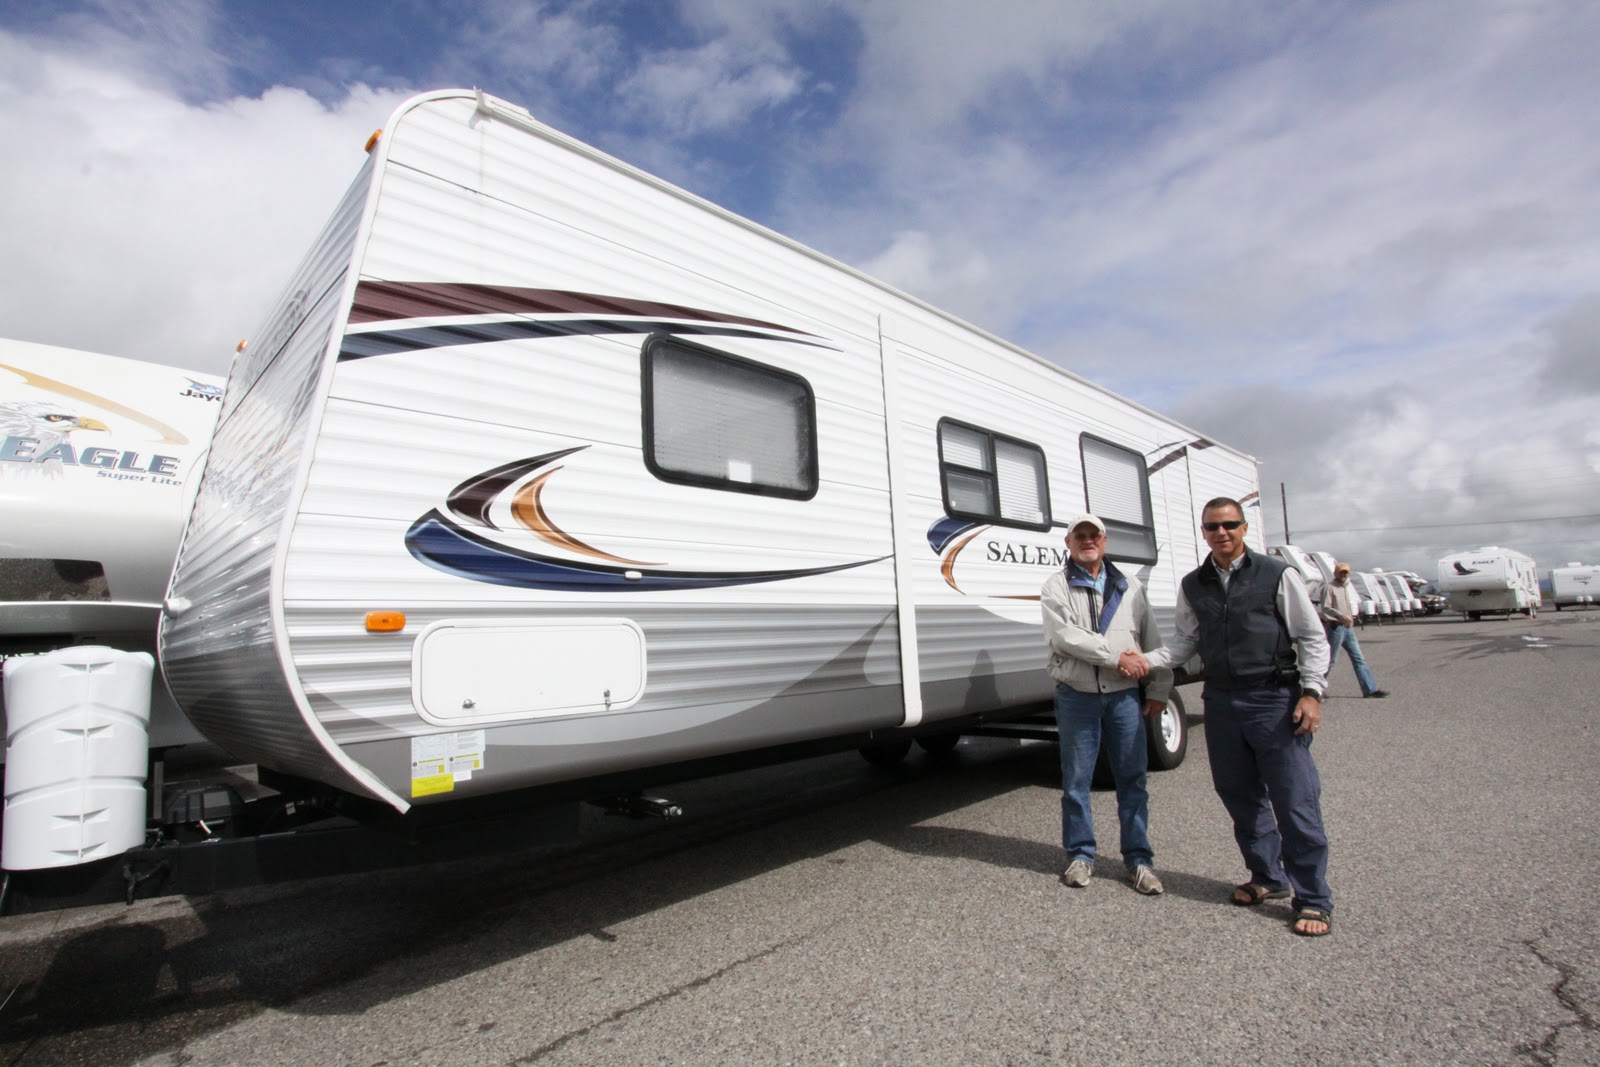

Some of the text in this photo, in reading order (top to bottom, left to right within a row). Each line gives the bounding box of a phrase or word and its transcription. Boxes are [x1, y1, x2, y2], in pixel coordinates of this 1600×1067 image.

[0, 435, 181, 477] EAGLE
[97, 470, 182, 486] Super Lite
[987, 540, 1069, 567] SALEM
